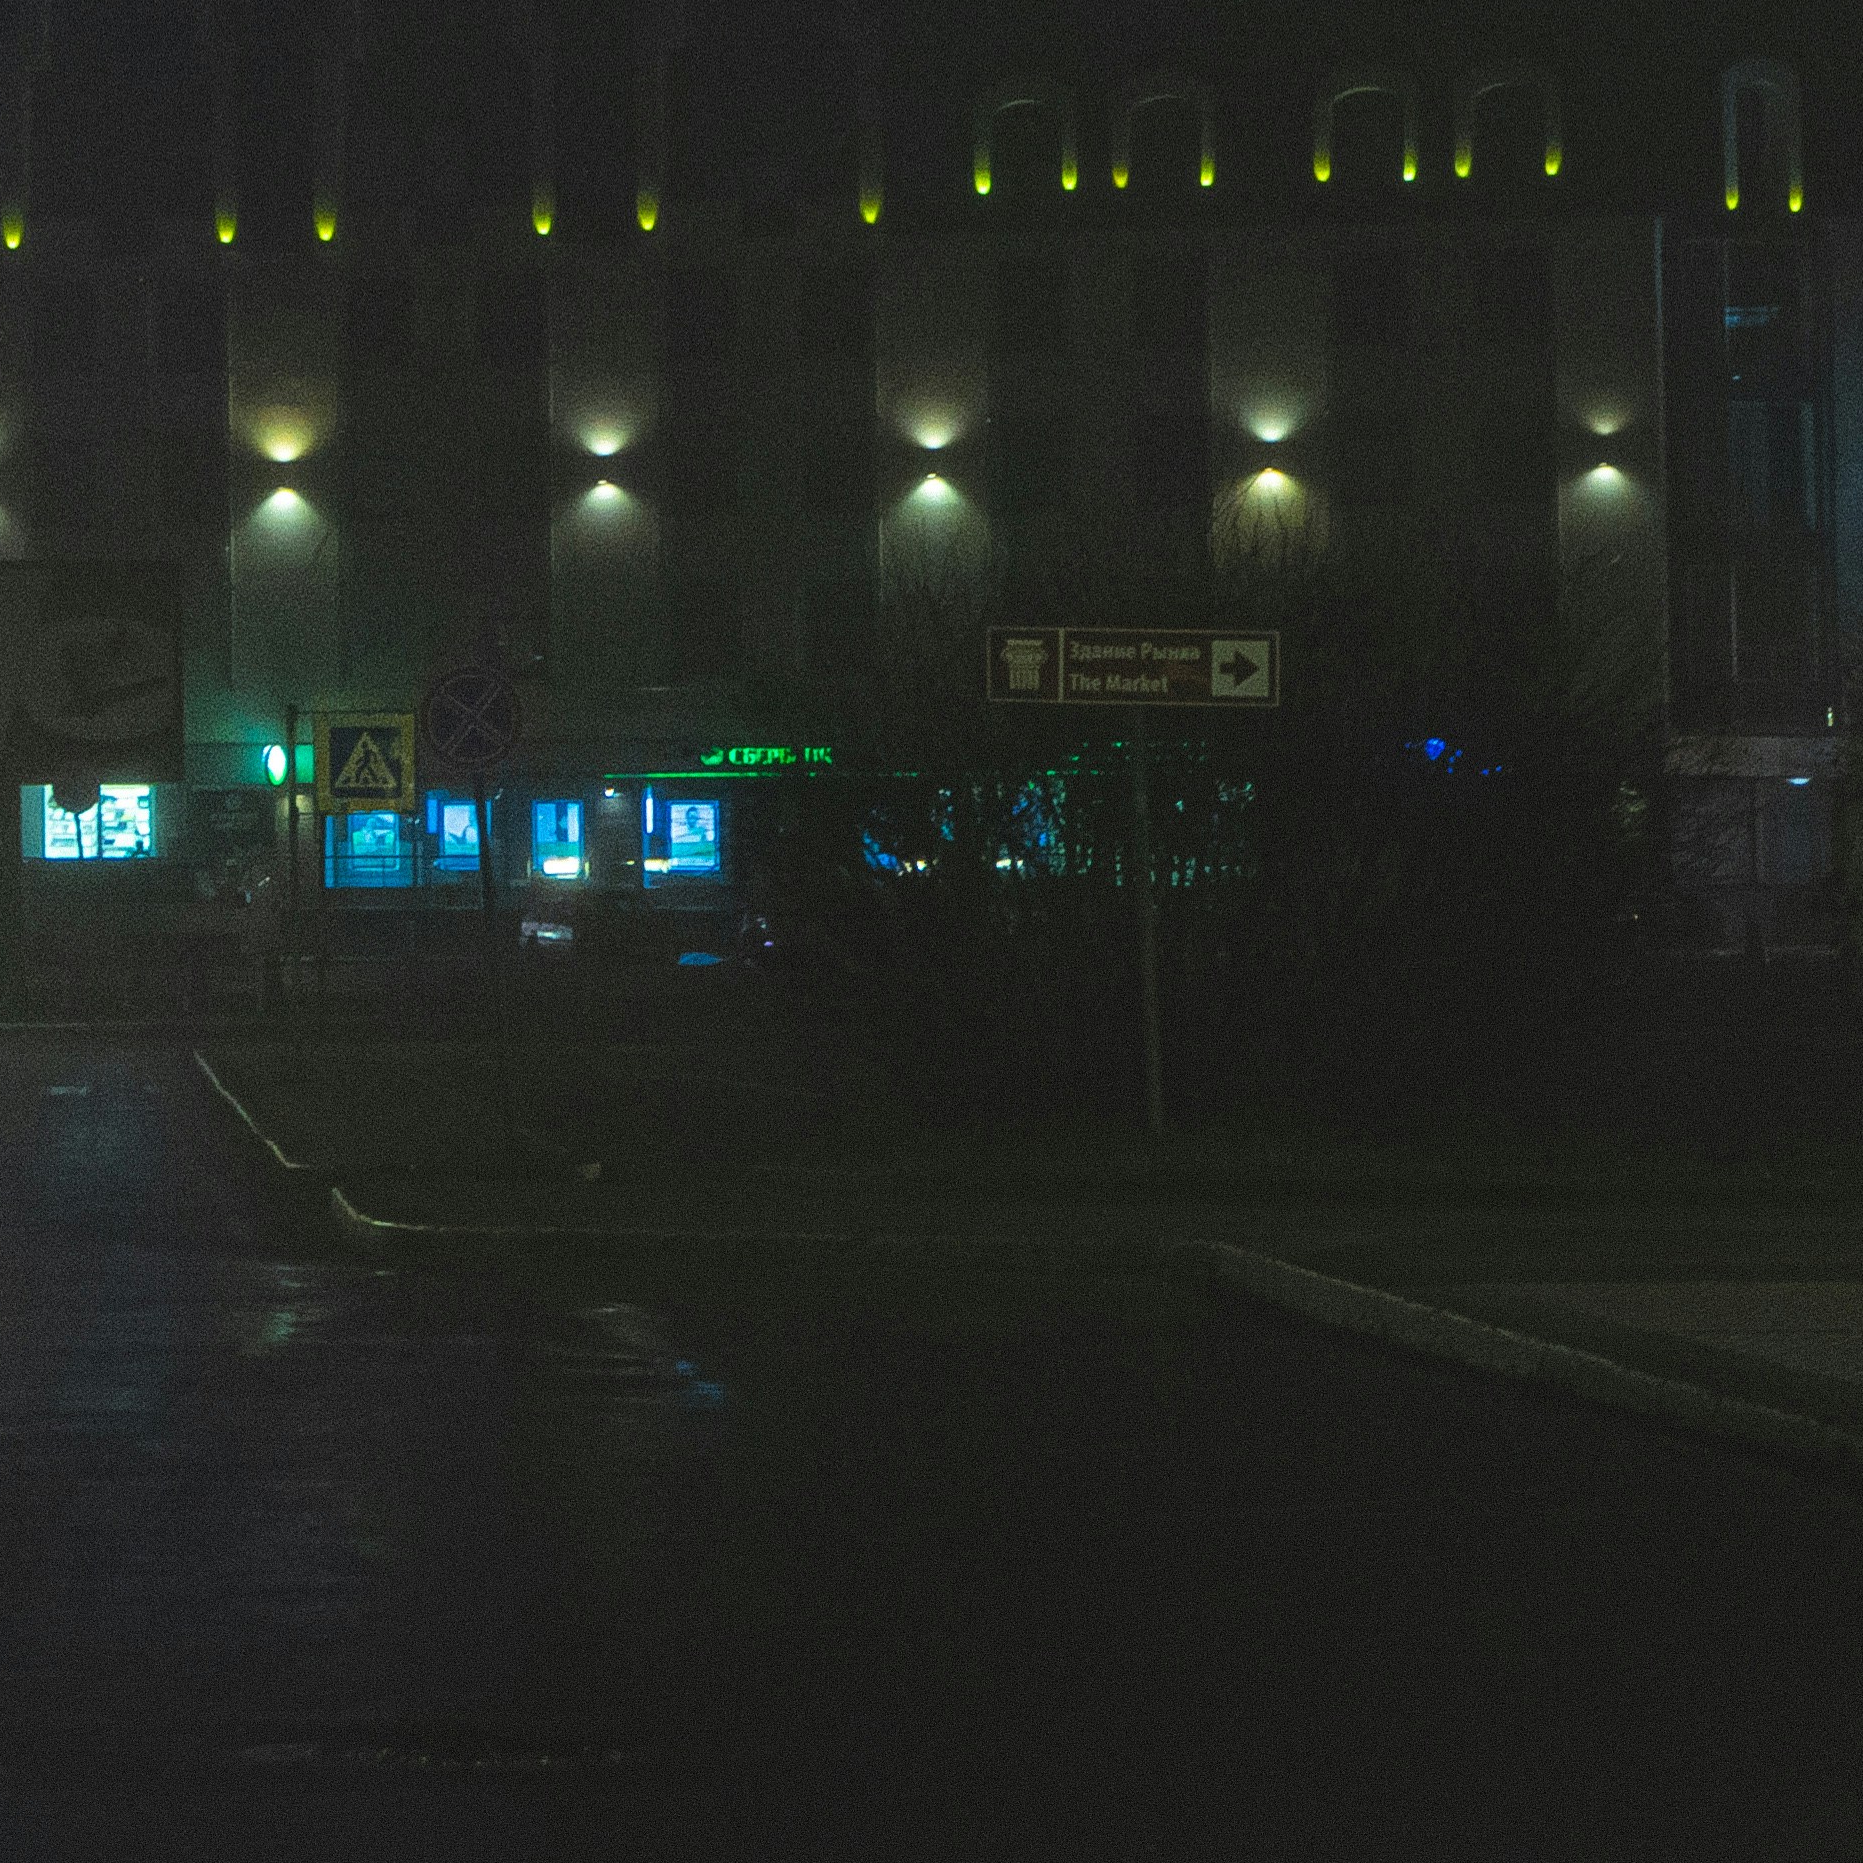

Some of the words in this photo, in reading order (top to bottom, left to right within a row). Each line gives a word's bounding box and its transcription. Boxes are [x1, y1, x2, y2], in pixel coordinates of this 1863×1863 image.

[1069, 641, 1137, 662] Здание
[1140, 642, 1201, 661] Рынка
[1068, 673, 1102, 692] The
[1105, 674, 1168, 693] Market
